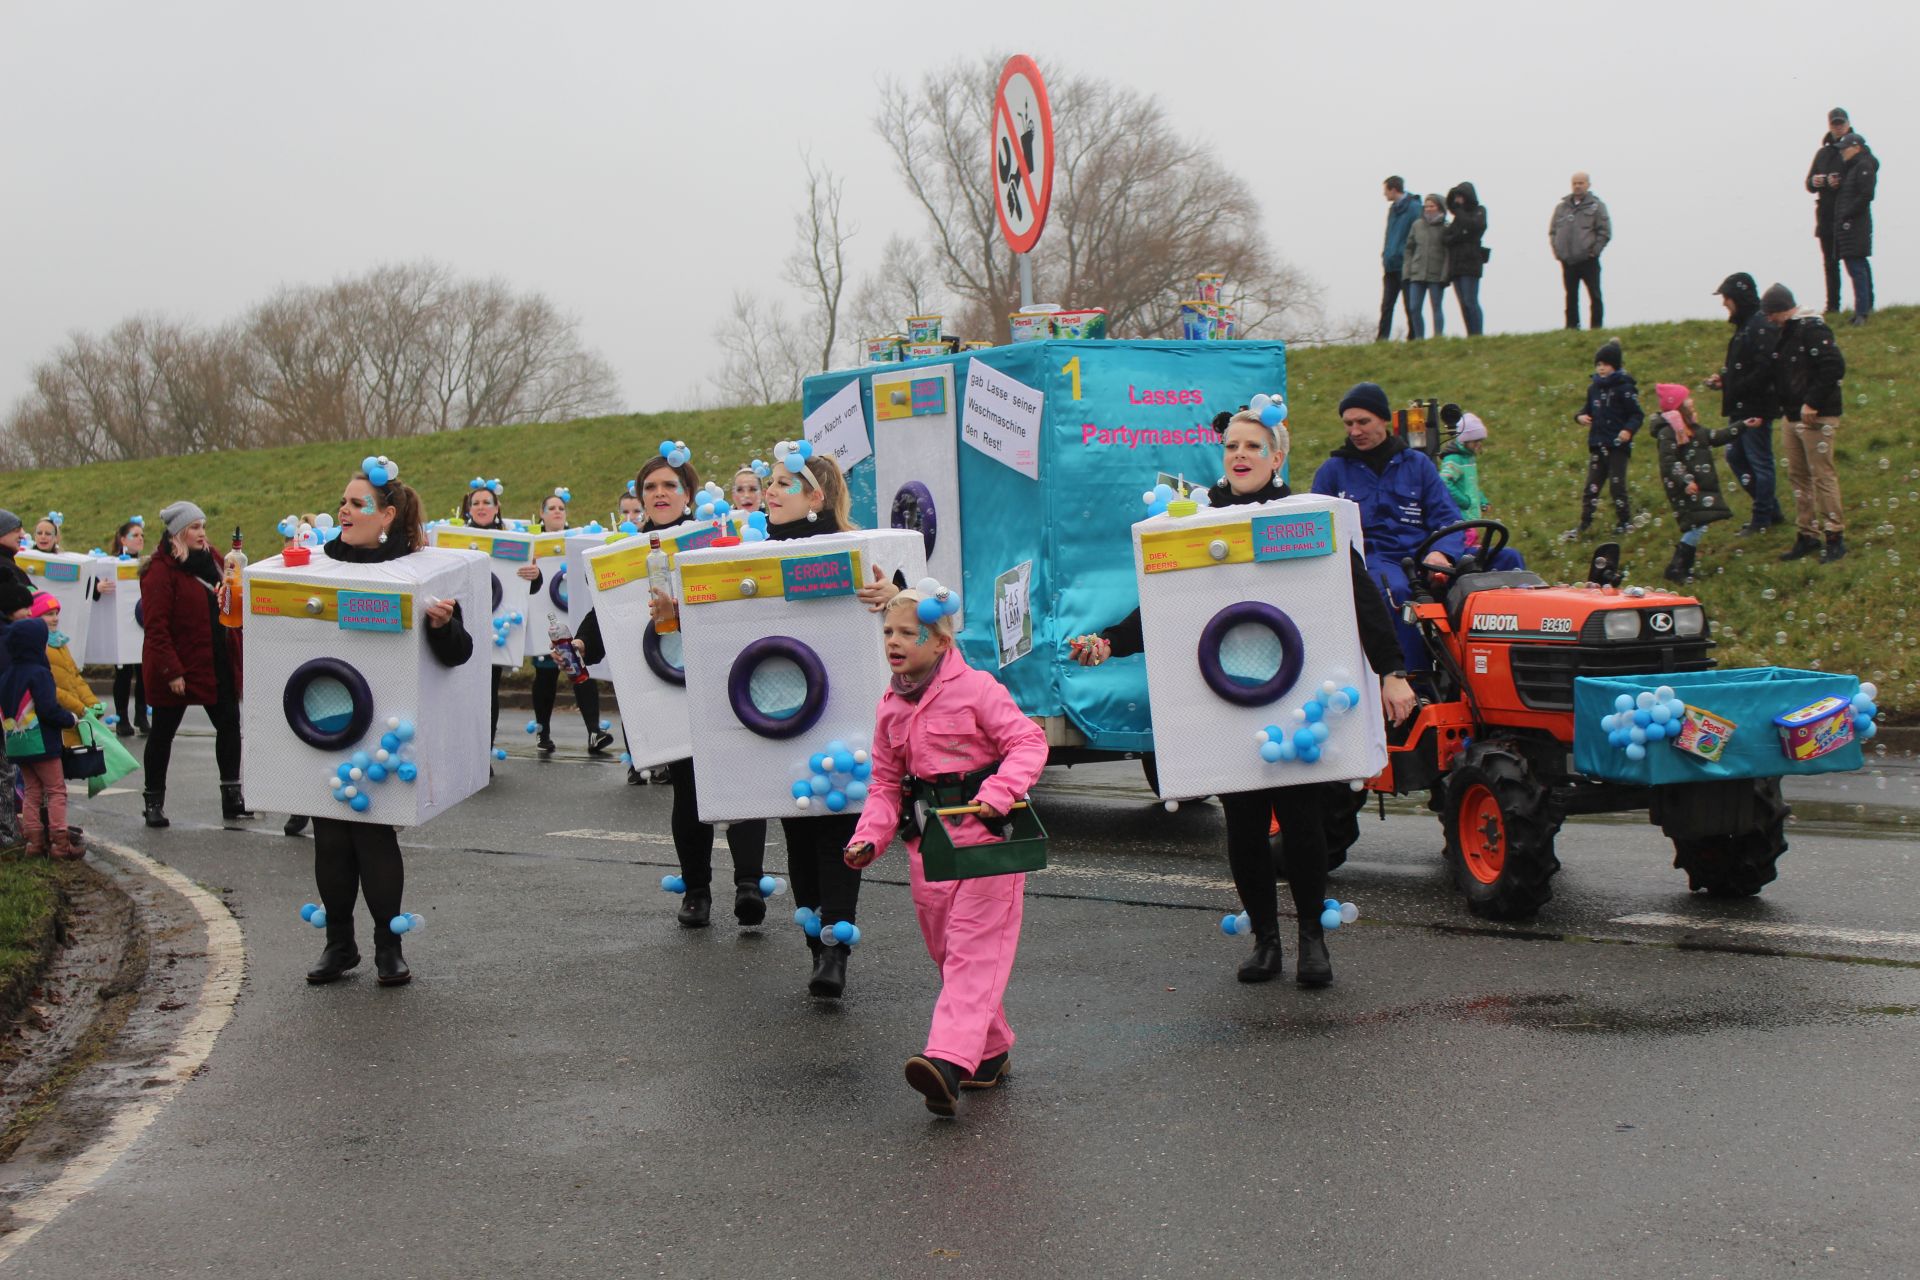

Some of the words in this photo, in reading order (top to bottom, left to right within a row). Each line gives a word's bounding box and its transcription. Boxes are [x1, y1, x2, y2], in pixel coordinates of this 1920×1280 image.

[1061, 356, 1082, 401] 1
[970, 374, 984, 387] gab
[986, 379, 1008, 400] Lasse
[1012, 395, 1037, 414] seiner
[1128, 384, 1204, 405] Lasses
[813, 431, 824, 444] der
[824, 414, 842, 434] Nacht
[843, 404, 858, 419] vom
[968, 396, 1027, 438] Waschmaschine
[965, 423, 978, 438] den
[983, 431, 1002, 451] Rest!
[1261, 544, 1292, 553] FEHLER
[1146, 561, 1178, 571] DEERNS
[687, 593, 717, 602] DEERNS
[1472, 614, 1519, 631] KUBOTA
[1541, 617, 1573, 633] B2410
[1701, 719, 1726, 738] Persil
